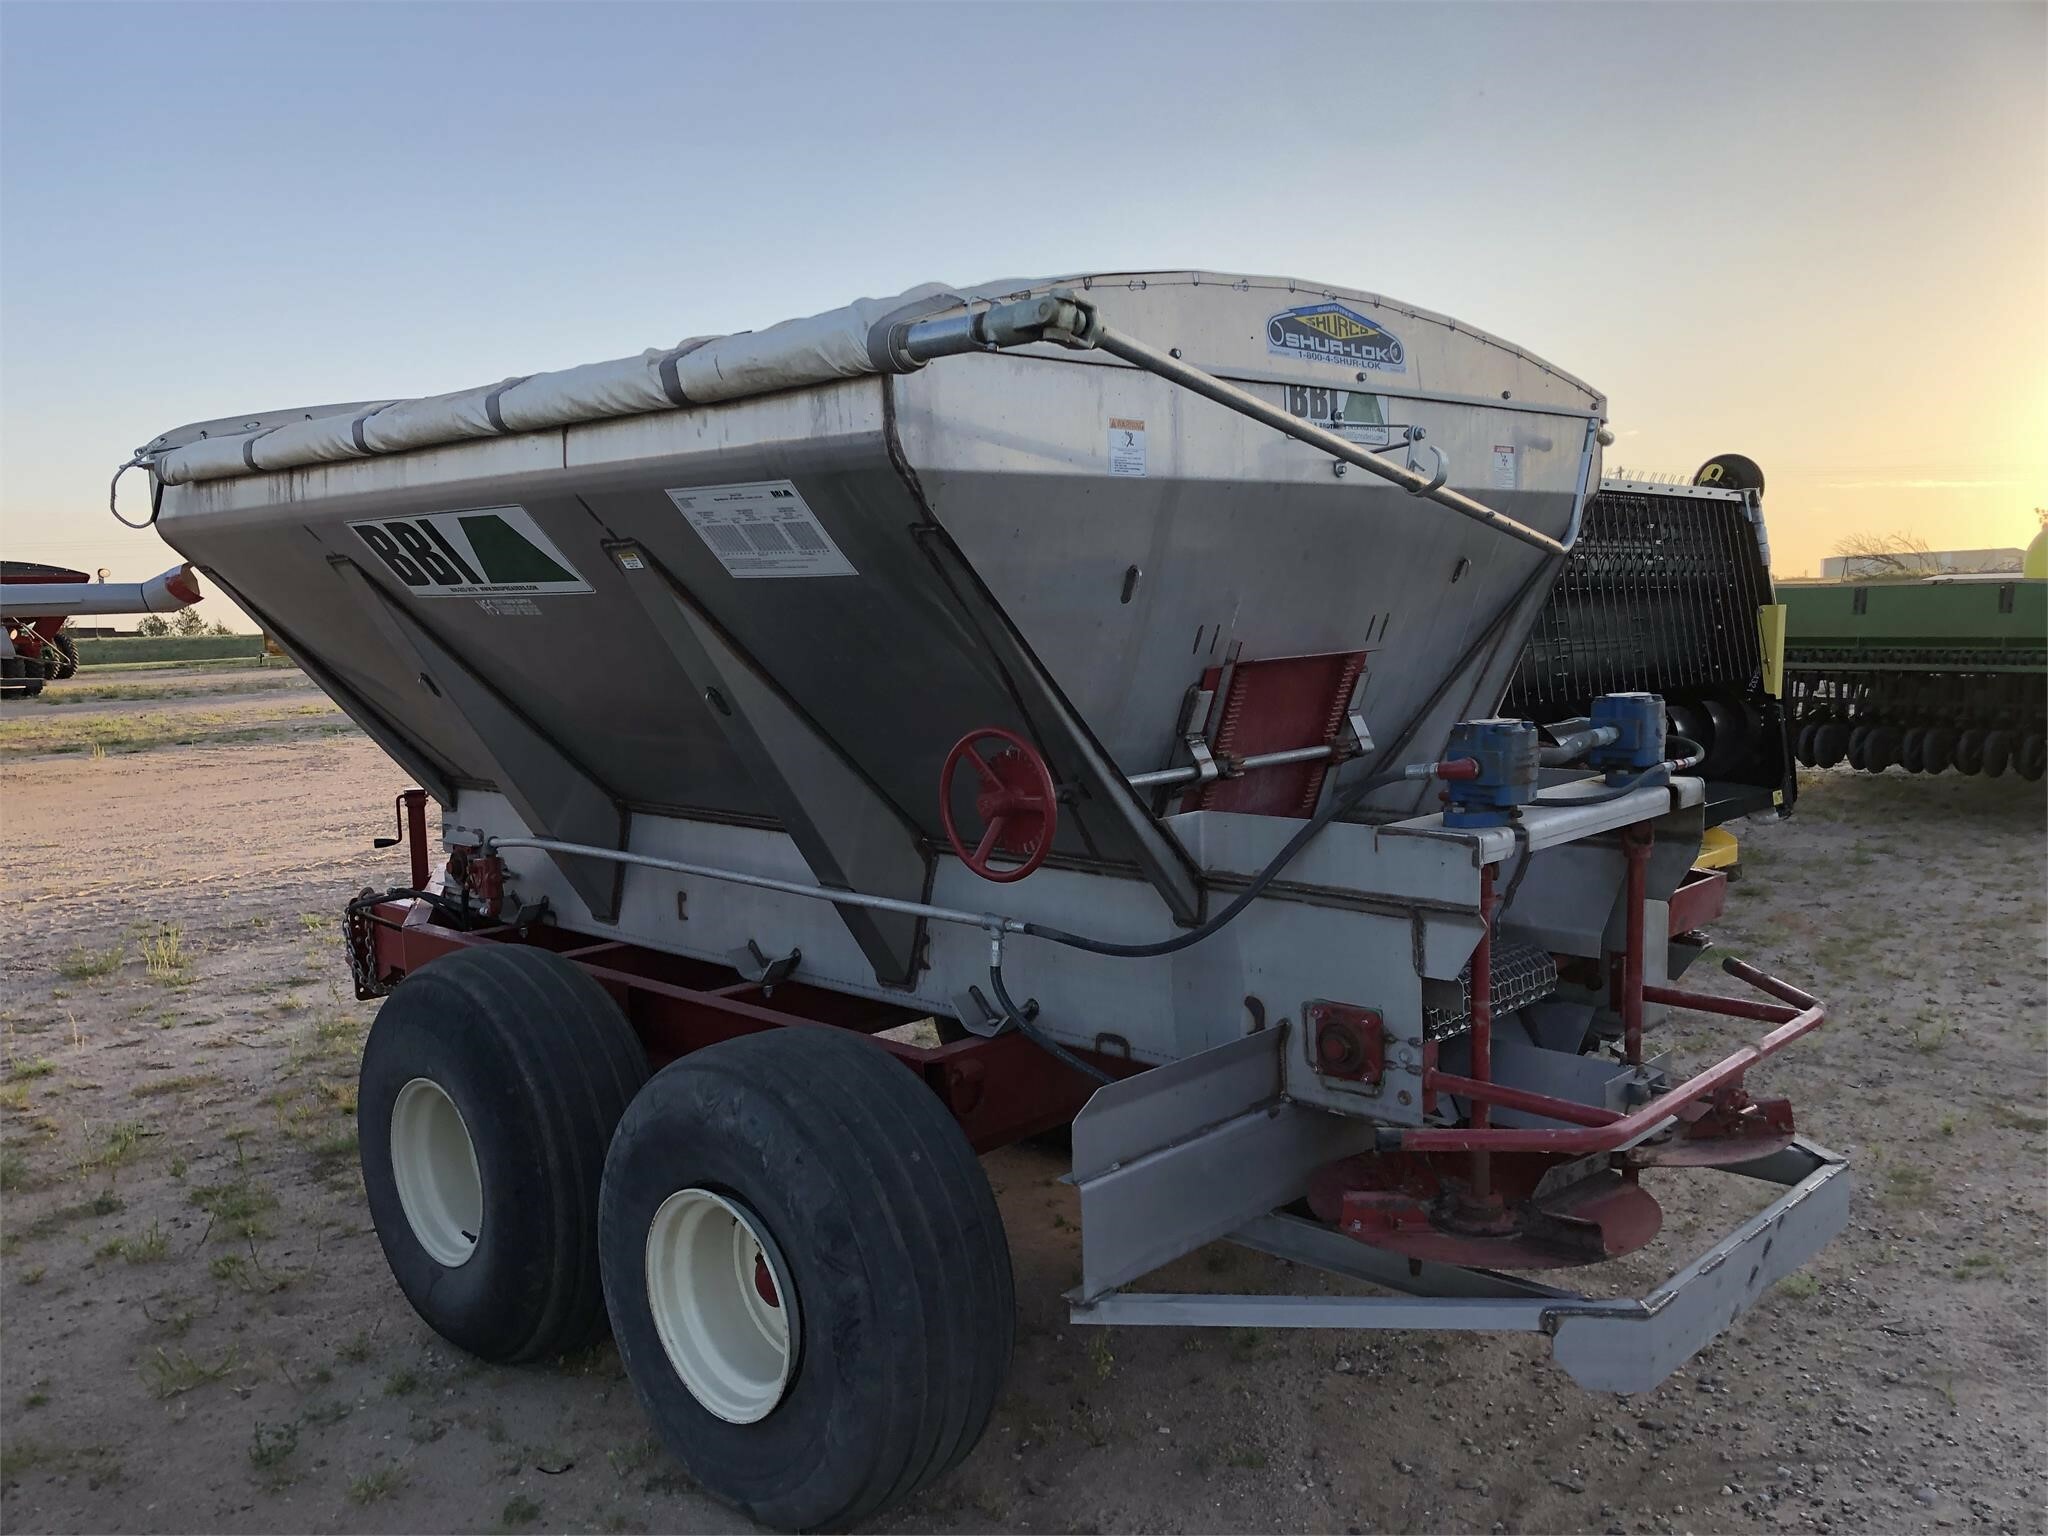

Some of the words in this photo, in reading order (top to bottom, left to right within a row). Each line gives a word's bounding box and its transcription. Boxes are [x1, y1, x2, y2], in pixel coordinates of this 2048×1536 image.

[1306, 315, 1369, 337] SHURCO
[1285, 333, 1389, 361] SHUR-LOK
[1298, 350, 1381, 370] 1-800-4-SHUR-LOK
[1289, 385, 1338, 420] BBI
[353, 518, 485, 586] BBI
